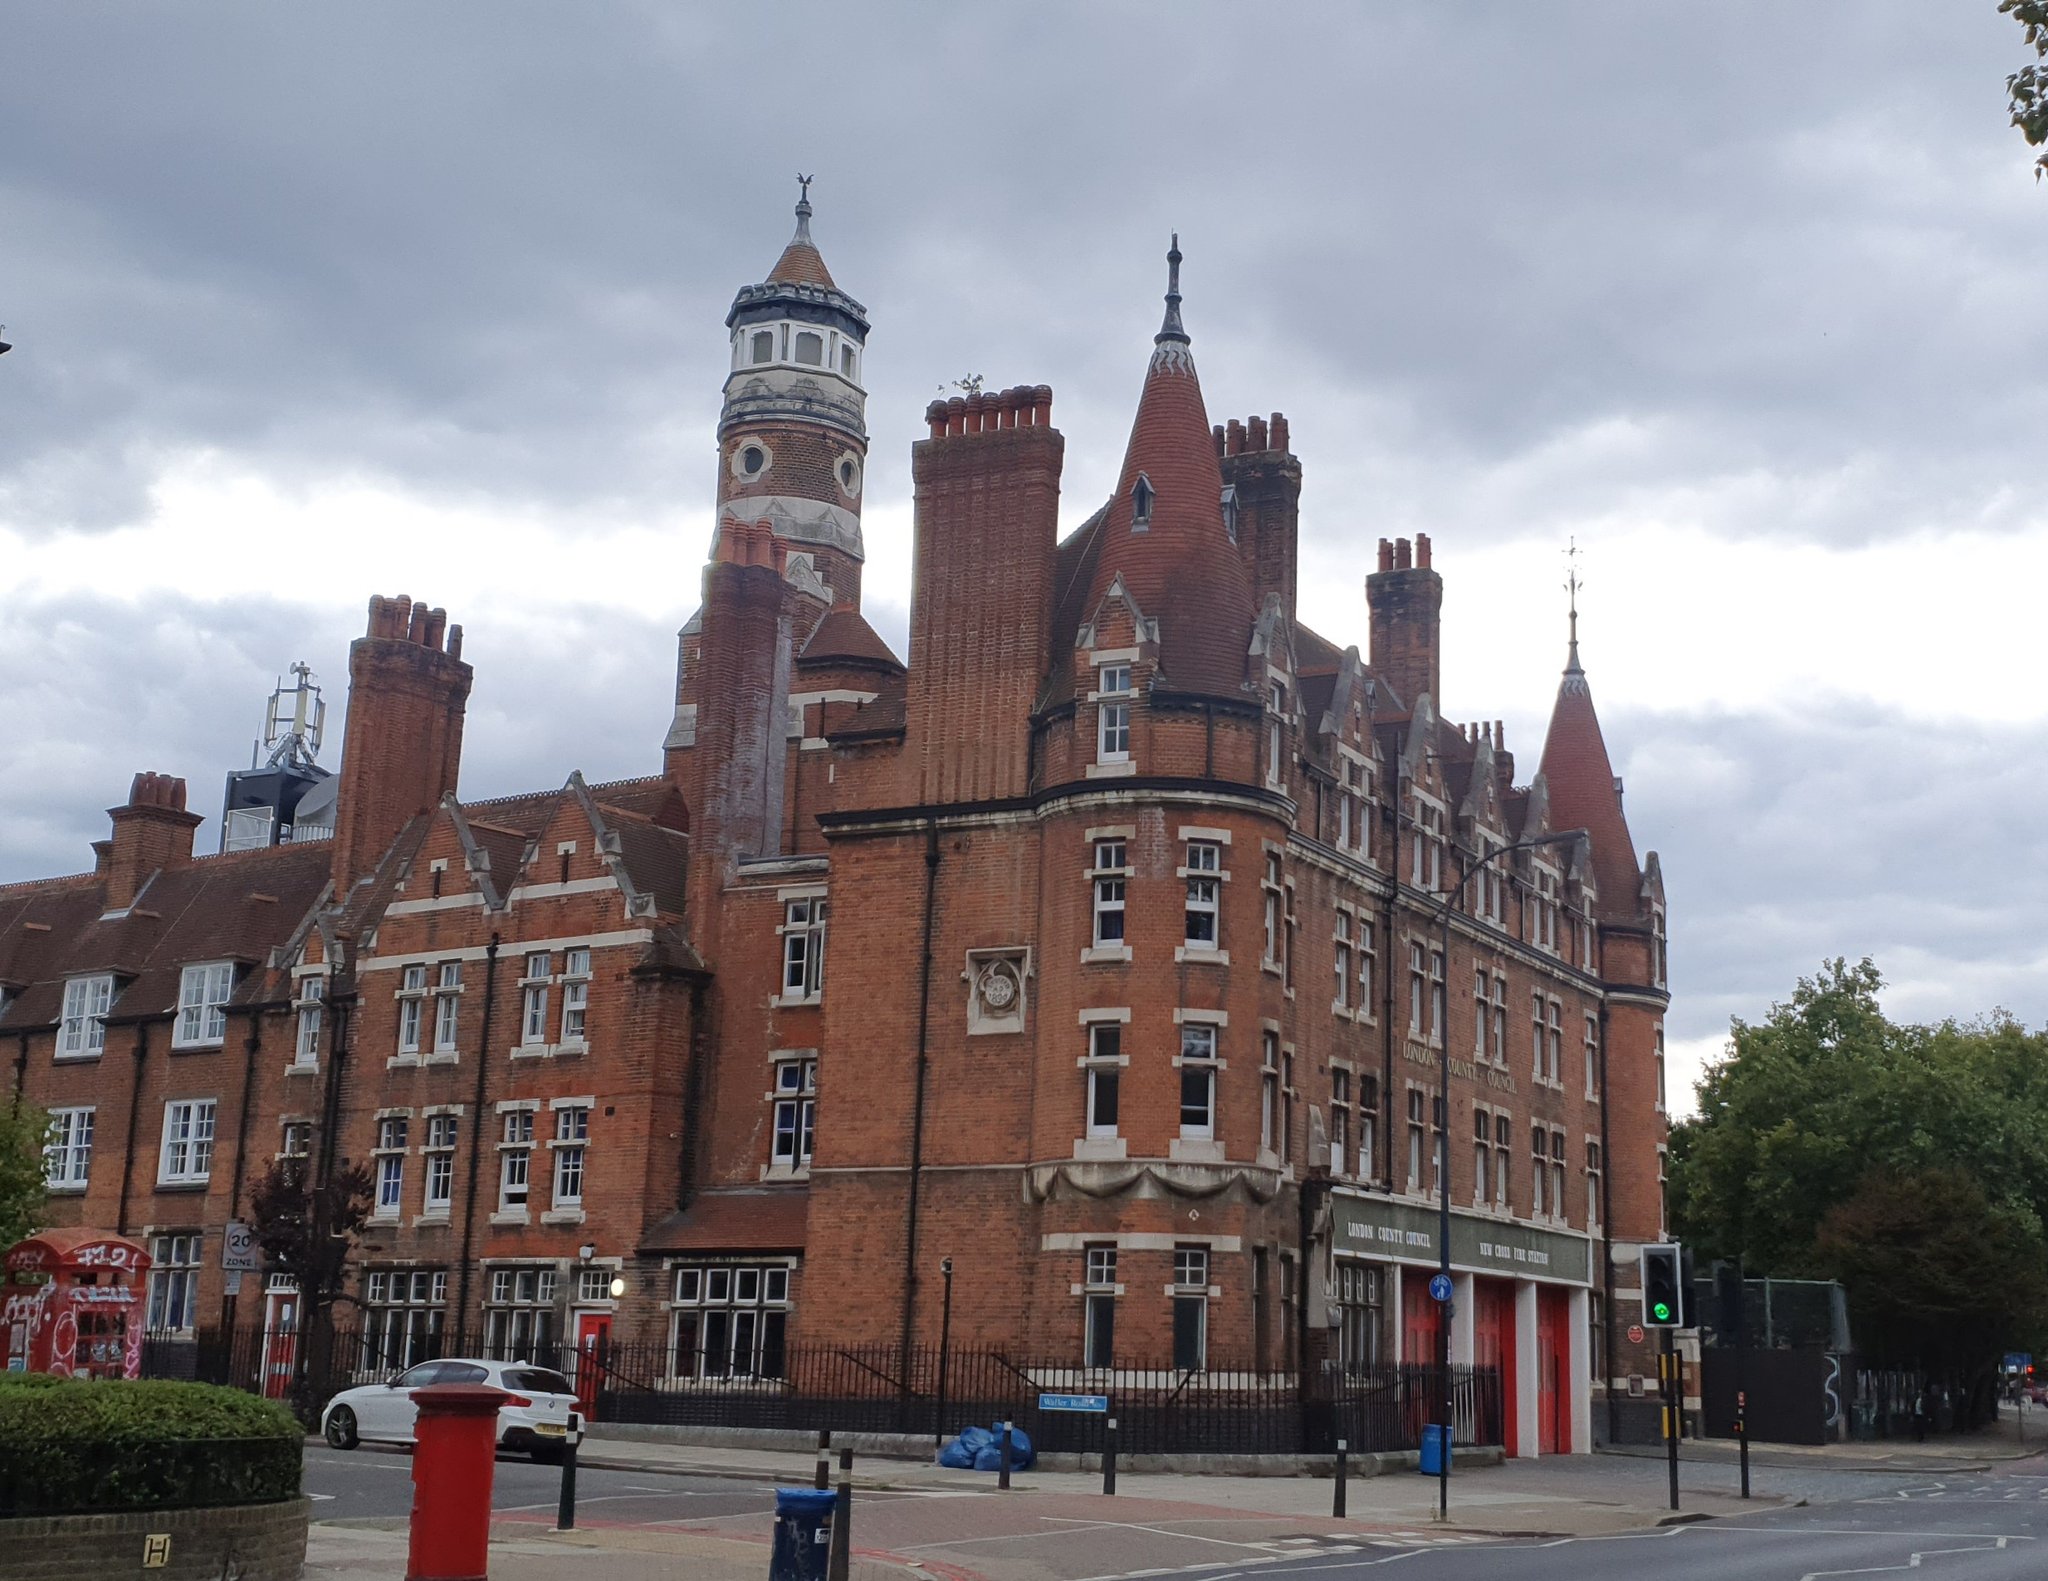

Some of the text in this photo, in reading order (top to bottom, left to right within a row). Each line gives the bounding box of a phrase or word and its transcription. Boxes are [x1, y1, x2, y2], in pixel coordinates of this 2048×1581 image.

[1403, 1041, 1517, 1094] LONDON COUNTY COUNCIL
[231, 1234, 250, 1248] 20
[1348, 1222, 1431, 1248] LONDON COUNTY COUNCIL
[226, 1258, 252, 1266] ZONE
[1479, 1242, 1549, 1266] NEW CROSS FIRE STATION
[147, 1538, 167, 1564] H
